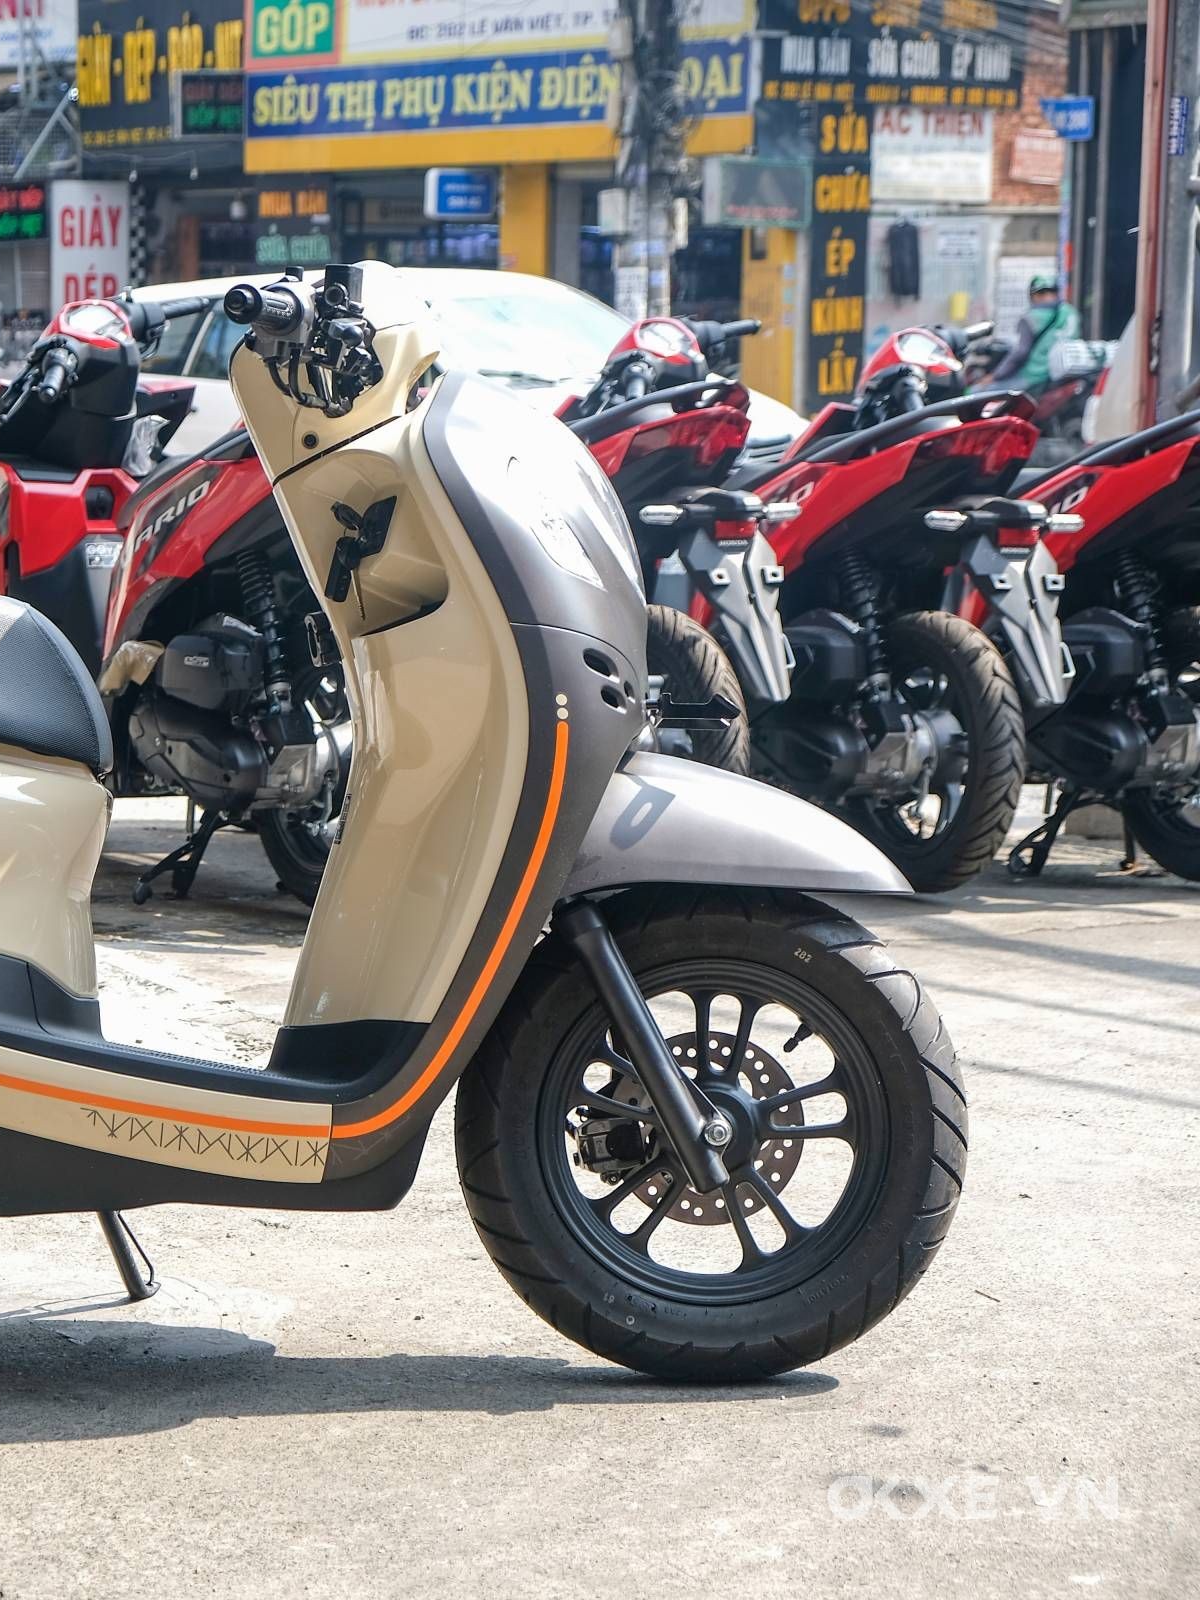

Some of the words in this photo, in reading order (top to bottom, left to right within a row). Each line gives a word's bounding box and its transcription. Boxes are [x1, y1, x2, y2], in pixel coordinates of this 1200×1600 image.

[253, 73, 320, 126] SIÊU
[324, 79, 377, 130] THỊ
[382, 74, 447, 126] PHỤ
[452, 59, 534, 123] KIỆN
[538, 53, 622, 119] ĐIỆN
[679, 53, 744, 111] OẠI
[60, 194, 122, 248] GIÀY
[825, 226, 855, 277] ÉP
[64, 263, 119, 304] DÉP
[133, 480, 211, 553] ARIO
